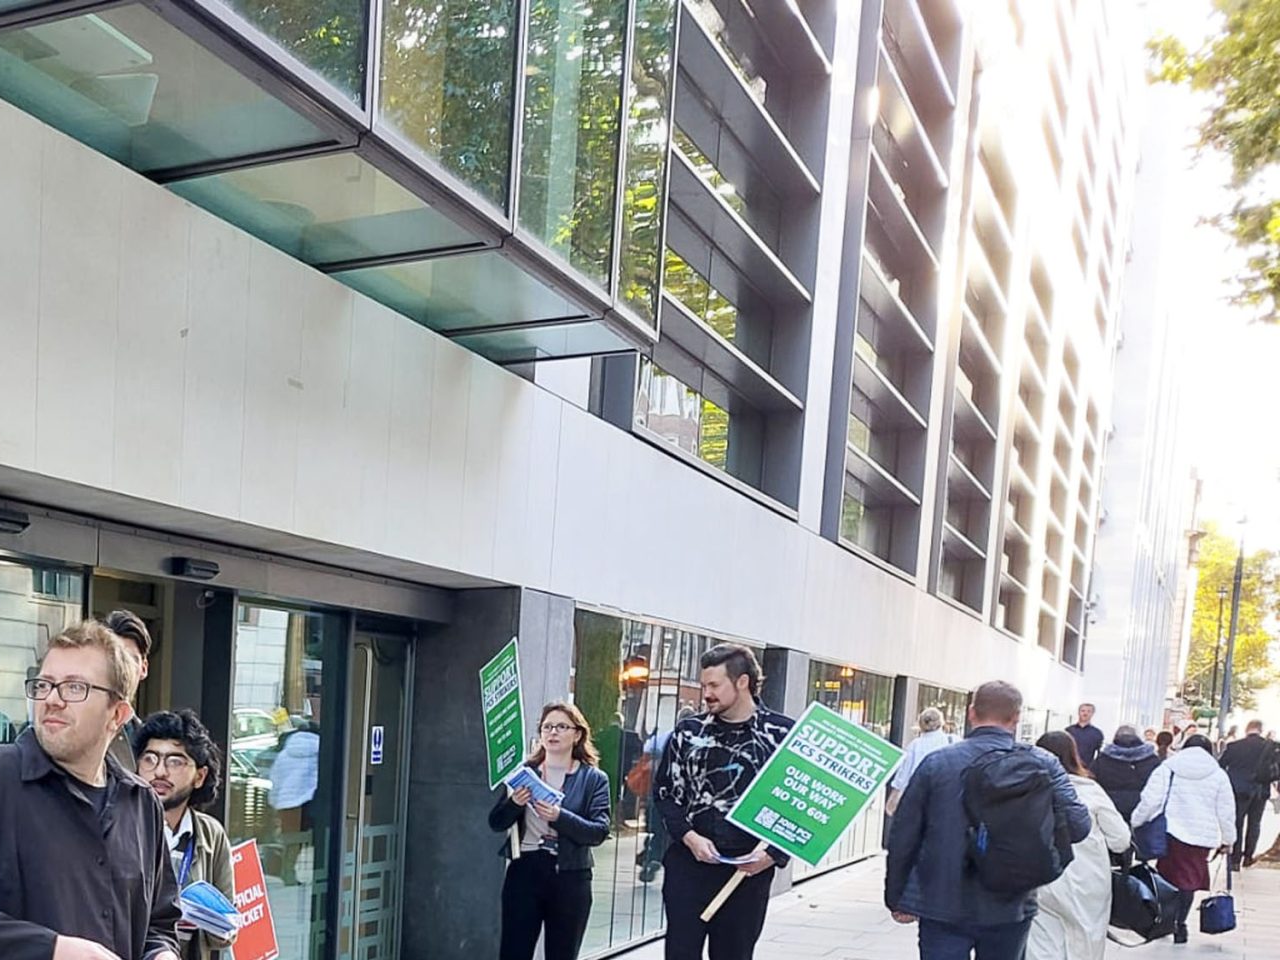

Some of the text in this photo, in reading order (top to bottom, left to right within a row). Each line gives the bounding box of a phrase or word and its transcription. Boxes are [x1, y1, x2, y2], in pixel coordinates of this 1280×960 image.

[792, 738, 814, 758] PCS
[815, 752, 873, 792] STRIKERS
[799, 725, 887, 780] SUPPORT
[771, 786, 830, 825] NO TO 60%
[783, 776, 838, 811] OUR WAY
[785, 765, 848, 806] OUR WORK
